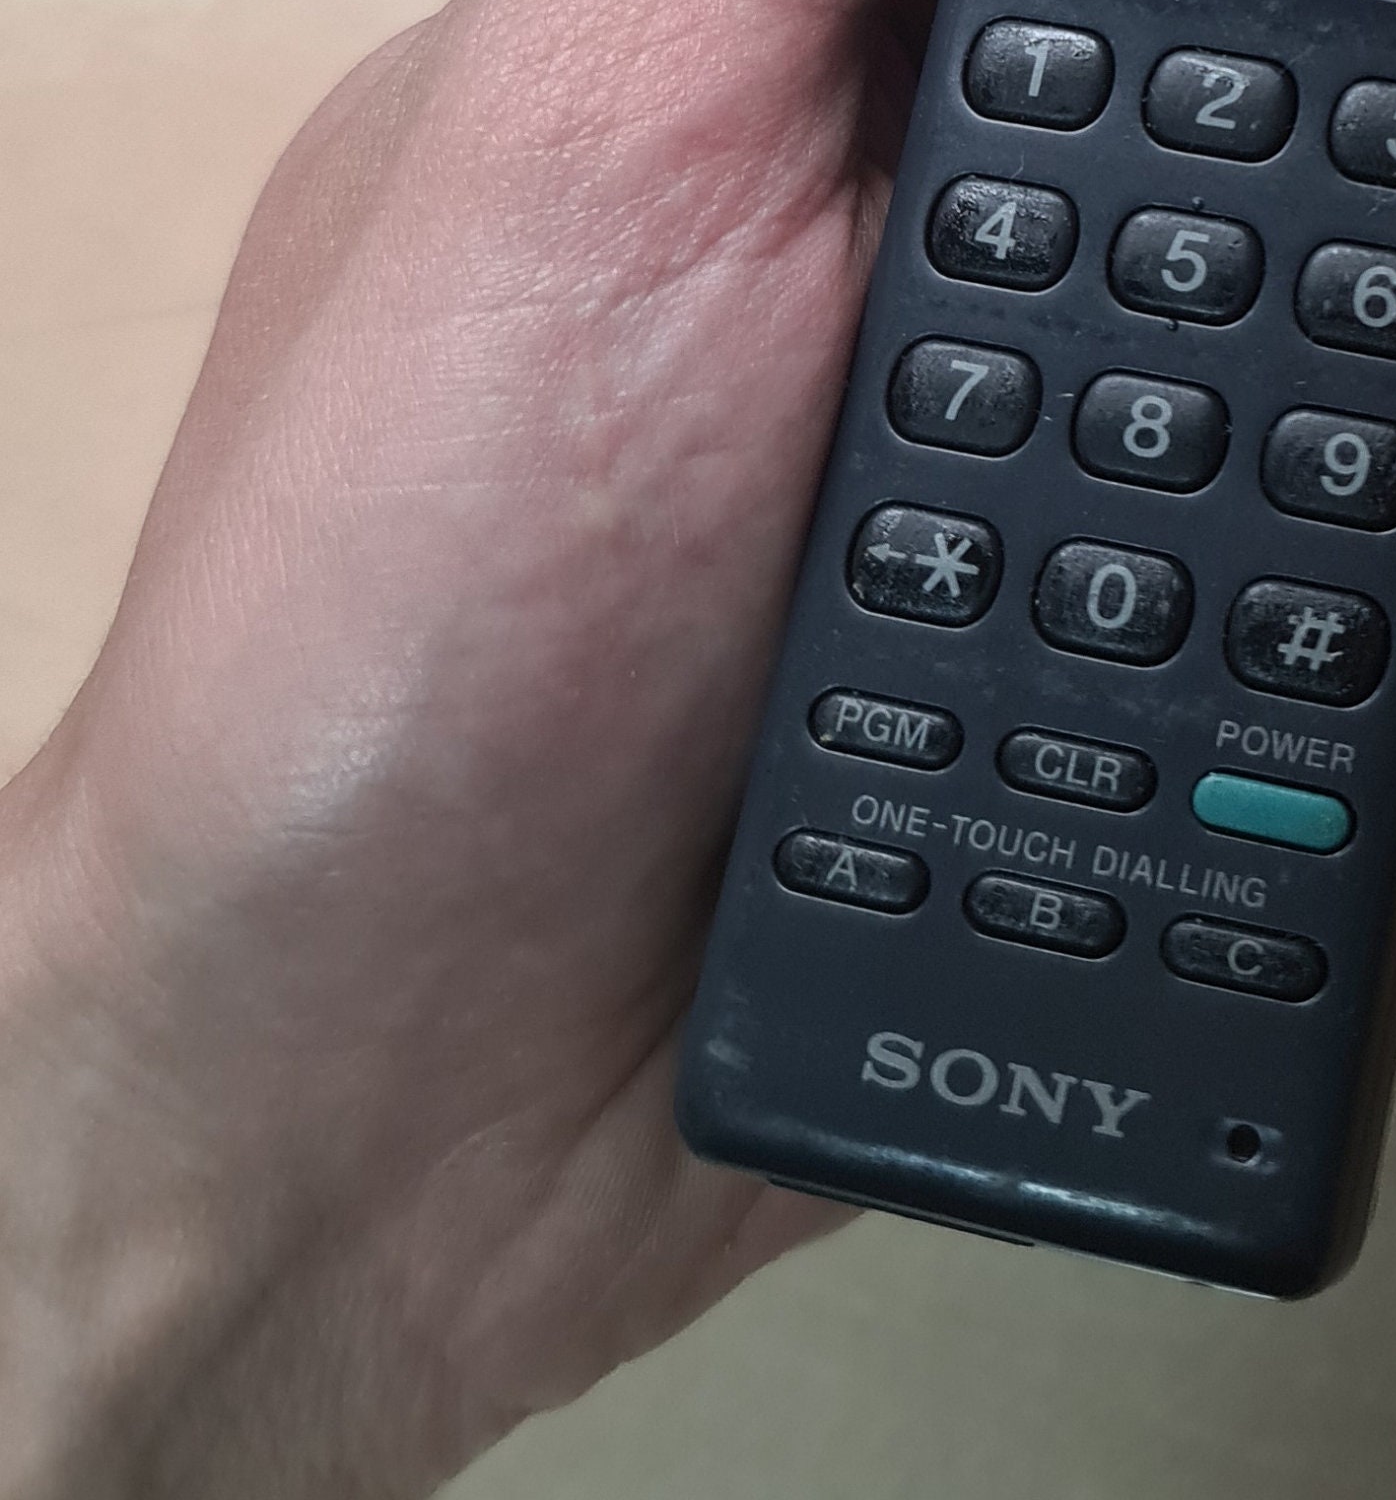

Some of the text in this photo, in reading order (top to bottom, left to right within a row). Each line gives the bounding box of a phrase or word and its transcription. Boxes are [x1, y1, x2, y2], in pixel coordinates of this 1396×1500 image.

[1025, 40, 1050, 98] 1
[1195, 70, 1248, 130] 2
[974, 201, 1018, 260] 4
[1160, 230, 1210, 292] 5
[944, 359, 989, 421] 7
[1122, 395, 1173, 459] 8
[1319, 432, 1371, 496] 9
[1086, 563, 1138, 629] 0
[1276, 606, 1346, 672] #
[835, 699, 931, 751] PGM
[1215, 719, 1356, 773] POWER
[1034, 744, 1123, 794] CLR
[826, 850, 859, 889] A
[851, 795, 1269, 909] ONE-TOUCH DIALLING
[1030, 895, 1064, 932] B
[1227, 940, 1264, 978] C
[860, 1031, 1152, 1139] SONY
